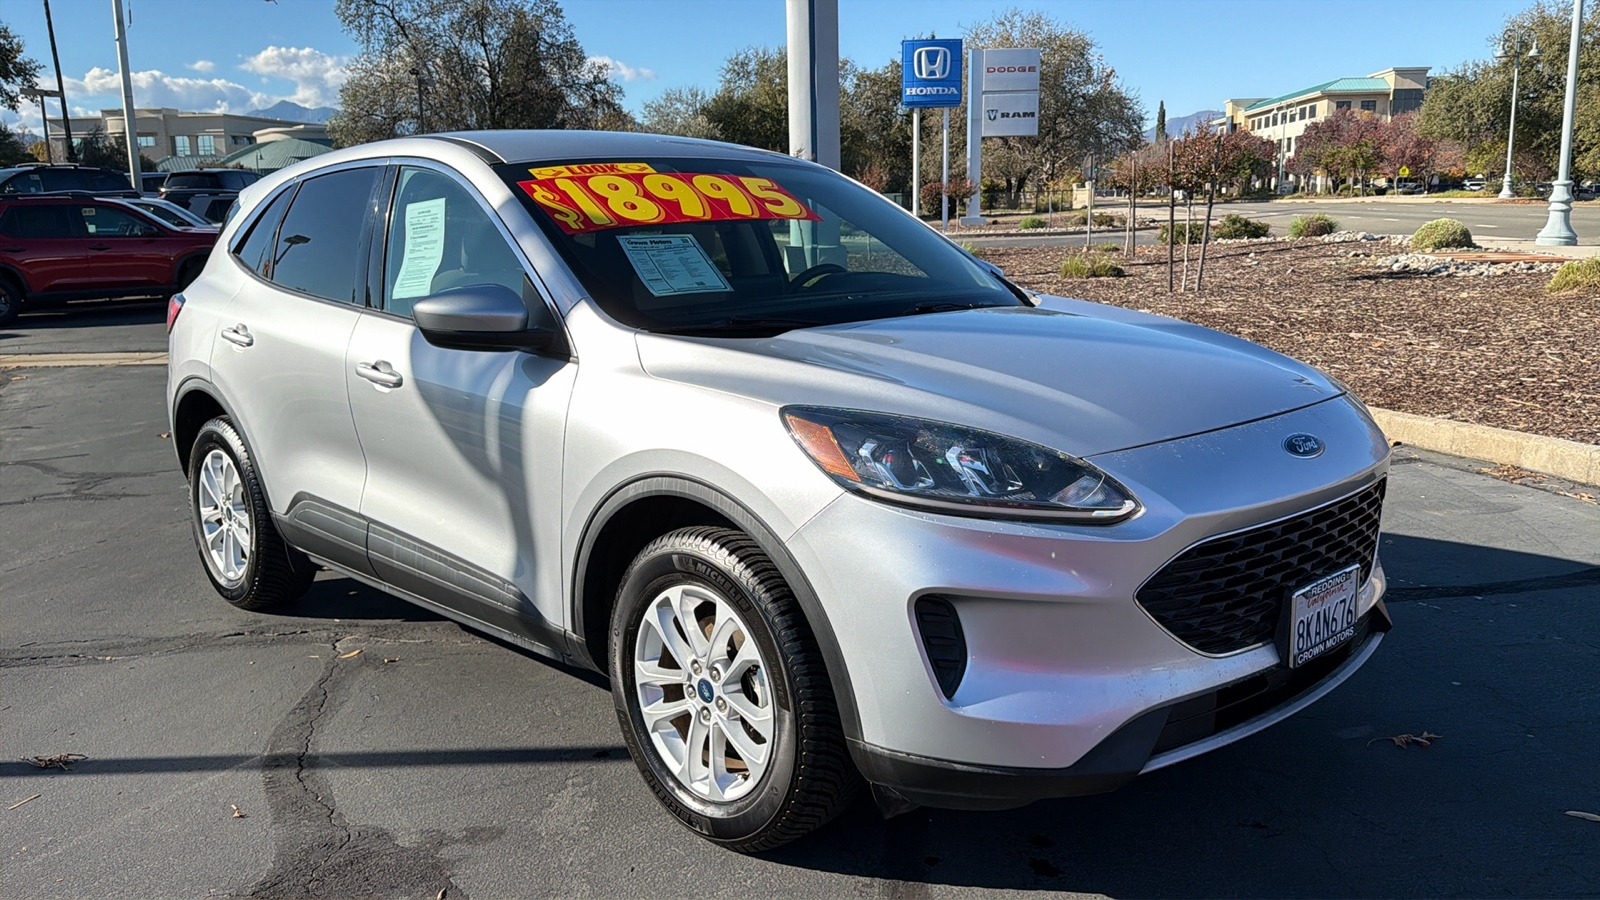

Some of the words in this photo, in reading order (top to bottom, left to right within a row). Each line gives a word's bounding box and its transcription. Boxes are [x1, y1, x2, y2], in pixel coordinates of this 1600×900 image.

[905, 87, 959, 96] HONDA
[564, 163, 625, 175] LOOK
[533, 174, 806, 229] $18995
[1292, 436, 1318, 453] Ford
[694, 563, 750, 612] MICHELIN
[1311, 573, 1346, 595] REDDING
[1296, 593, 1355, 652] 8KAN676
[1297, 641, 1325, 664] CROWN
[1325, 626, 1354, 647] MOTORS
